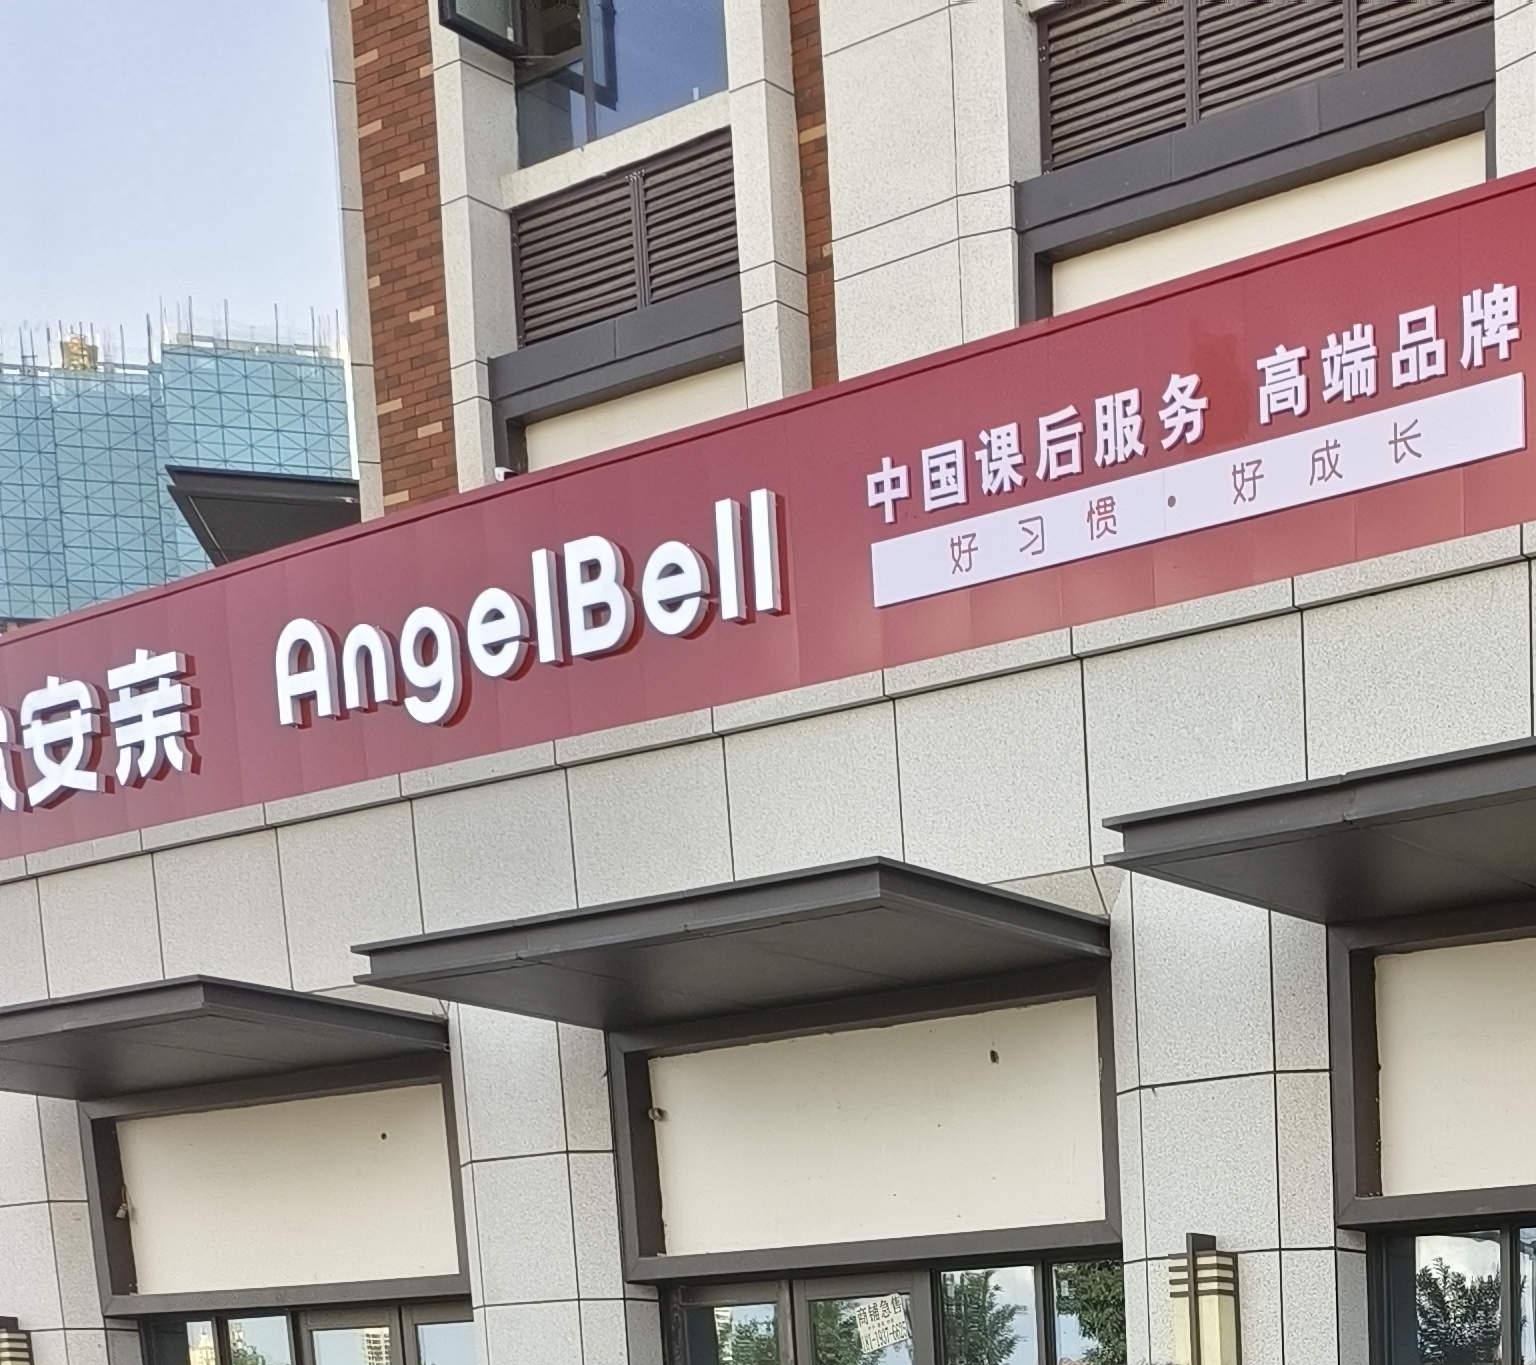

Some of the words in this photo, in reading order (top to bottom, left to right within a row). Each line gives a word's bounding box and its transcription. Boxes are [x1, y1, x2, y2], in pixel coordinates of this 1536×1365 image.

[866, 373, 1209, 523] 中国课后服务
[1256, 283, 1524, 425] 高端品牌
[275, 487, 786, 728] AngelBell
[0, 648, 195, 812] 安亲
